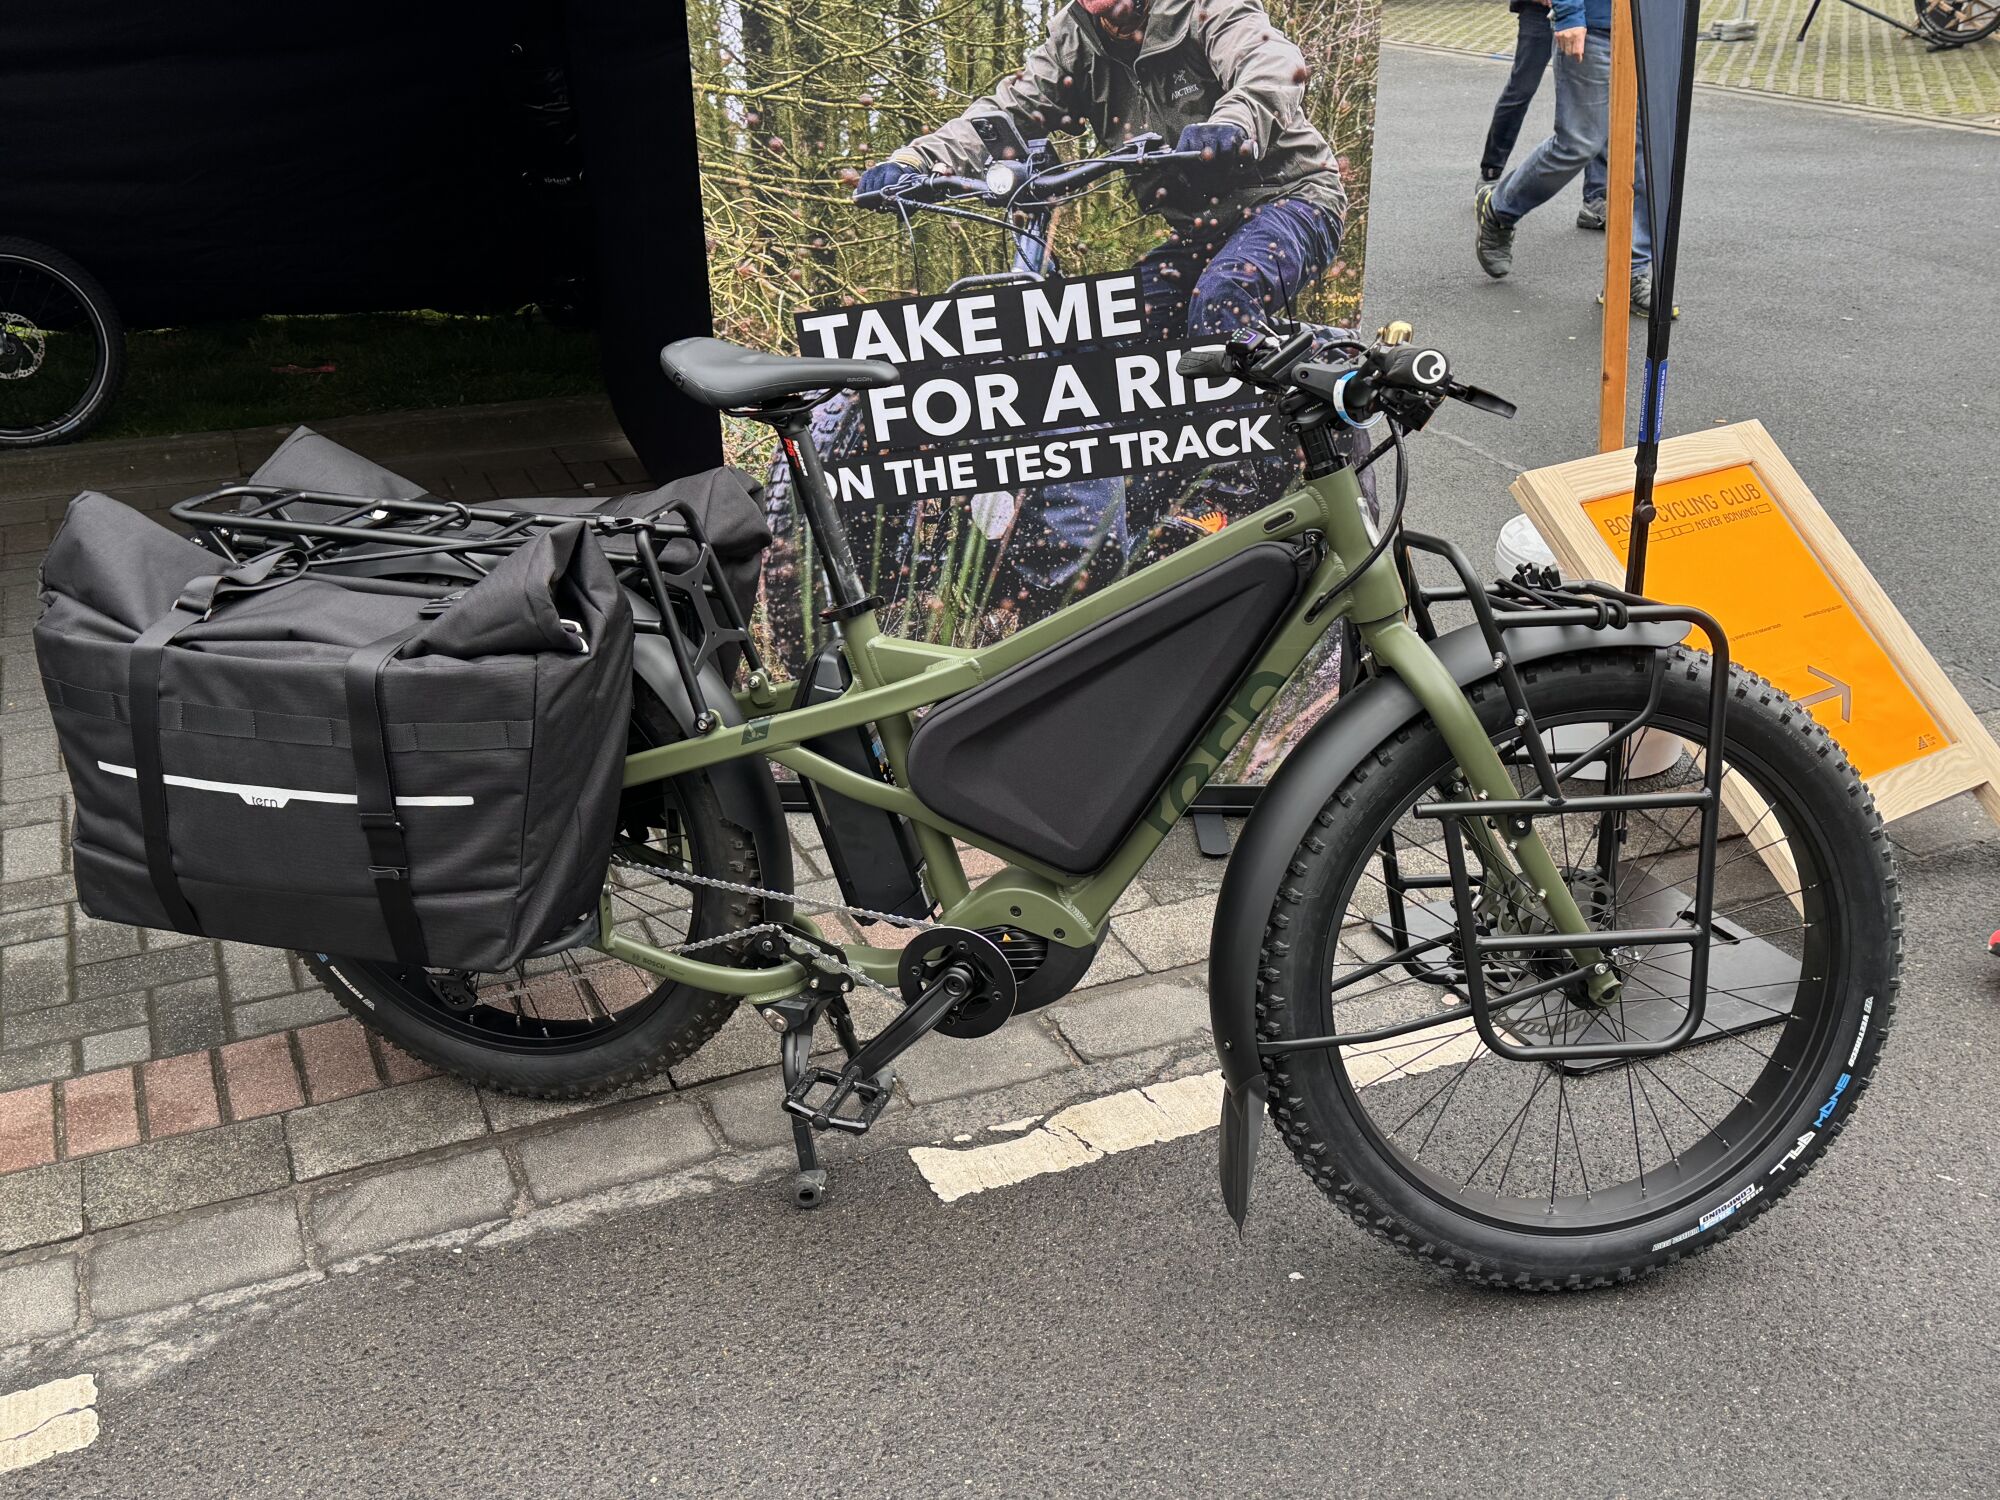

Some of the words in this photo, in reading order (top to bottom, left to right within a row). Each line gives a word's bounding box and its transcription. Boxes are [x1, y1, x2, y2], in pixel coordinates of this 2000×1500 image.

[802, 295, 1003, 364] TAKE
[1020, 275, 1142, 345] ME
[868, 373, 1026, 443] FOR
[1043, 370, 1100, 424] A
[1114, 336, 1288, 413] RID
[884, 453, 978, 496] THE
[985, 437, 1100, 482] TEST
[1110, 415, 1275, 469] TRACK
[1656, 494, 1717, 522] CYCLING
[1720, 483, 1761, 505] CLUB
[1694, 515, 1722, 531] NEVER
[1724, 507, 1758, 522] BONKING
[252, 796, 278, 808] tern
[643, 957, 665, 970] BOSCH
[1813, 1073, 1852, 1128] SNOW
[1702, 1186, 1753, 1223] COMPOUND
